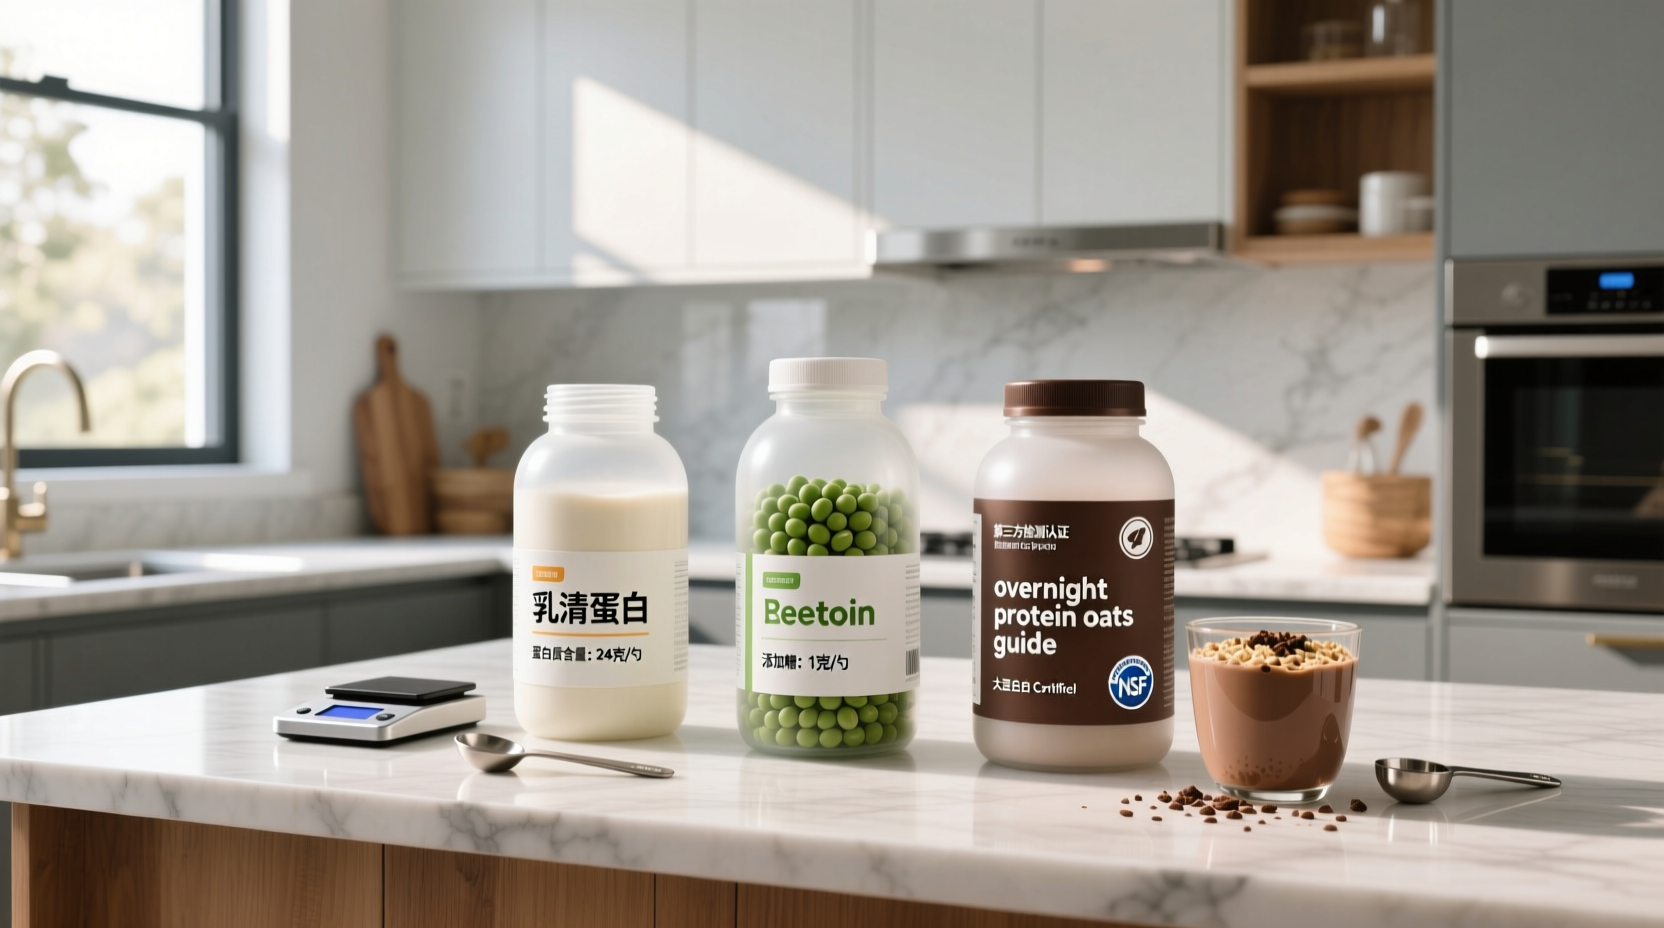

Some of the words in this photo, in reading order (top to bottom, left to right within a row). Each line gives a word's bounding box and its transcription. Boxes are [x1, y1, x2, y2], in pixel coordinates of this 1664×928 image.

[994, 576, 1108, 606] overnight
[533, 591, 647, 625] 乳清蛋白
[765, 598, 875, 627] Beetoin
[994, 603, 1077, 630] protein
[1083, 606, 1134, 627] oats
[993, 631, 1057, 659] guide
[1118, 675, 1148, 699] NSF
